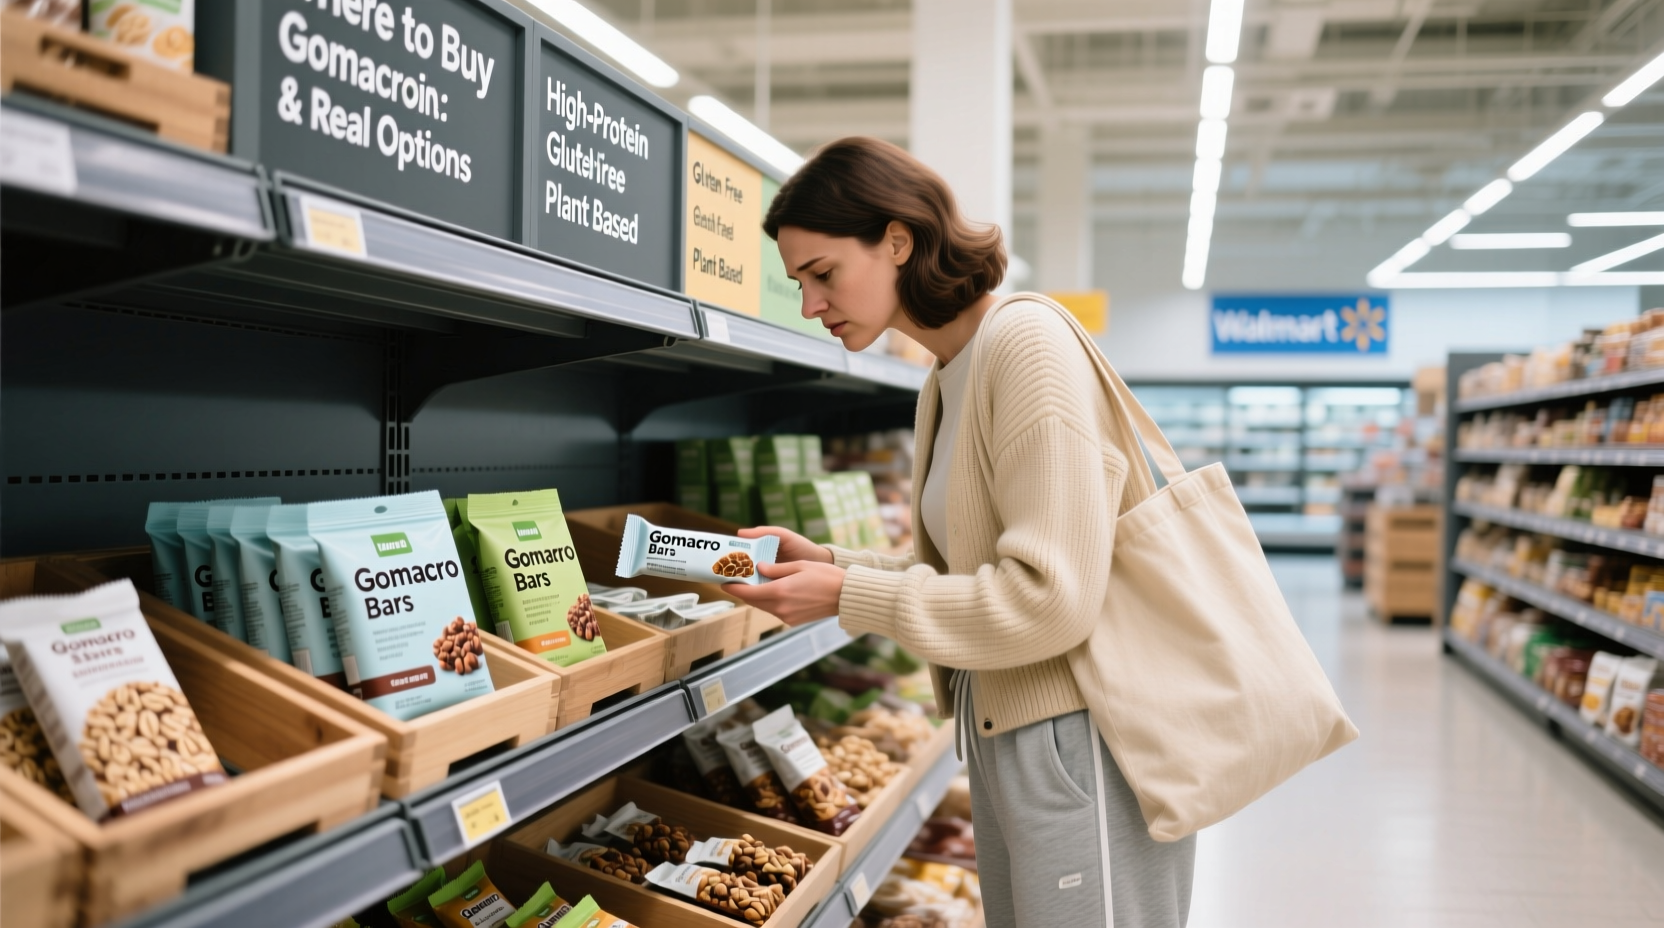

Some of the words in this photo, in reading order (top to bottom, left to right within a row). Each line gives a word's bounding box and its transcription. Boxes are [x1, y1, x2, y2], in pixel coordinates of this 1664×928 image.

[278, 10, 448, 122] Gomacroin:
[304, 0, 395, 41] ere
[402, 7, 434, 59] to
[441, 23, 495, 99] Buy
[278, 75, 303, 125] &
[310, 86, 371, 148] Real
[377, 115, 472, 182] Options
[547, 76, 649, 160] High-Protein
[545, 180, 589, 228] Plant
[592, 199, 639, 244] Based
[693, 247, 717, 276] Plant
[1212, 308, 1340, 343] Walmart
[649, 530, 721, 551] Gomacro
[354, 559, 459, 592] Gomacro
[513, 572, 551, 592] Bars
[364, 593, 414, 620] Bars
